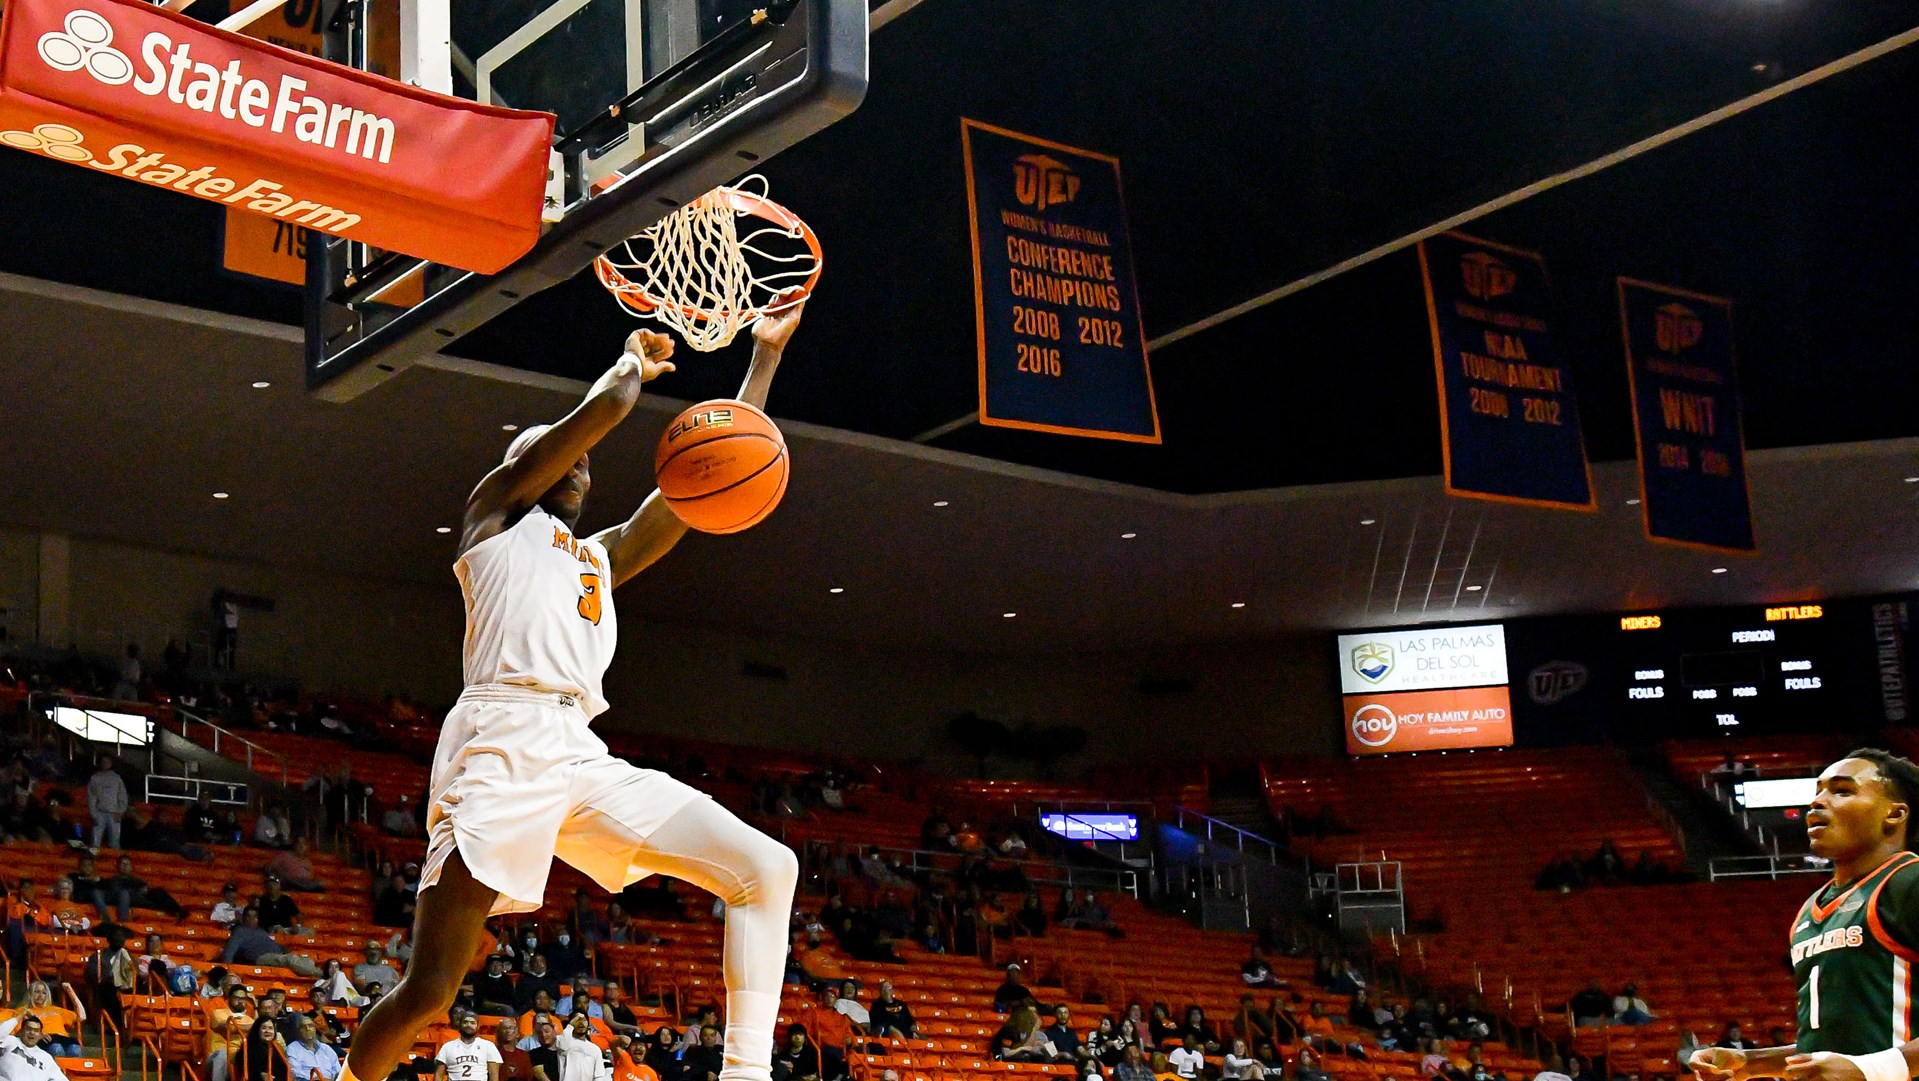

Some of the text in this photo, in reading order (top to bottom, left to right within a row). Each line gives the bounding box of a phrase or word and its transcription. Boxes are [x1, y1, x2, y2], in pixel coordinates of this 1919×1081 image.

[1013, 155, 1080, 211] UTEP
[1048, 221, 1110, 247] BASKETBALL
[1007, 235, 1115, 281] CONFERENCE
[1010, 268, 1120, 312] CHAMPIONS
[1013, 306, 1123, 348] 2008 2012
[1016, 343, 1061, 377] 2016
[1765, 605, 1823, 621] RATTLERS
[1621, 615, 1661, 630] MINERS
[1400, 634, 1494, 653] LAS PALMAS
[1417, 655, 1480, 671] DEL SOL
[1402, 671, 1497, 684] HEALTHCARE
[1785, 677, 1821, 689] FOULS
[1629, 686, 1664, 699] FOULS
[1398, 708, 1505, 725] HOY FAMILY AUTO
[1809, 965, 1820, 1029] 1
[462, 1065, 472, 1077] 2
